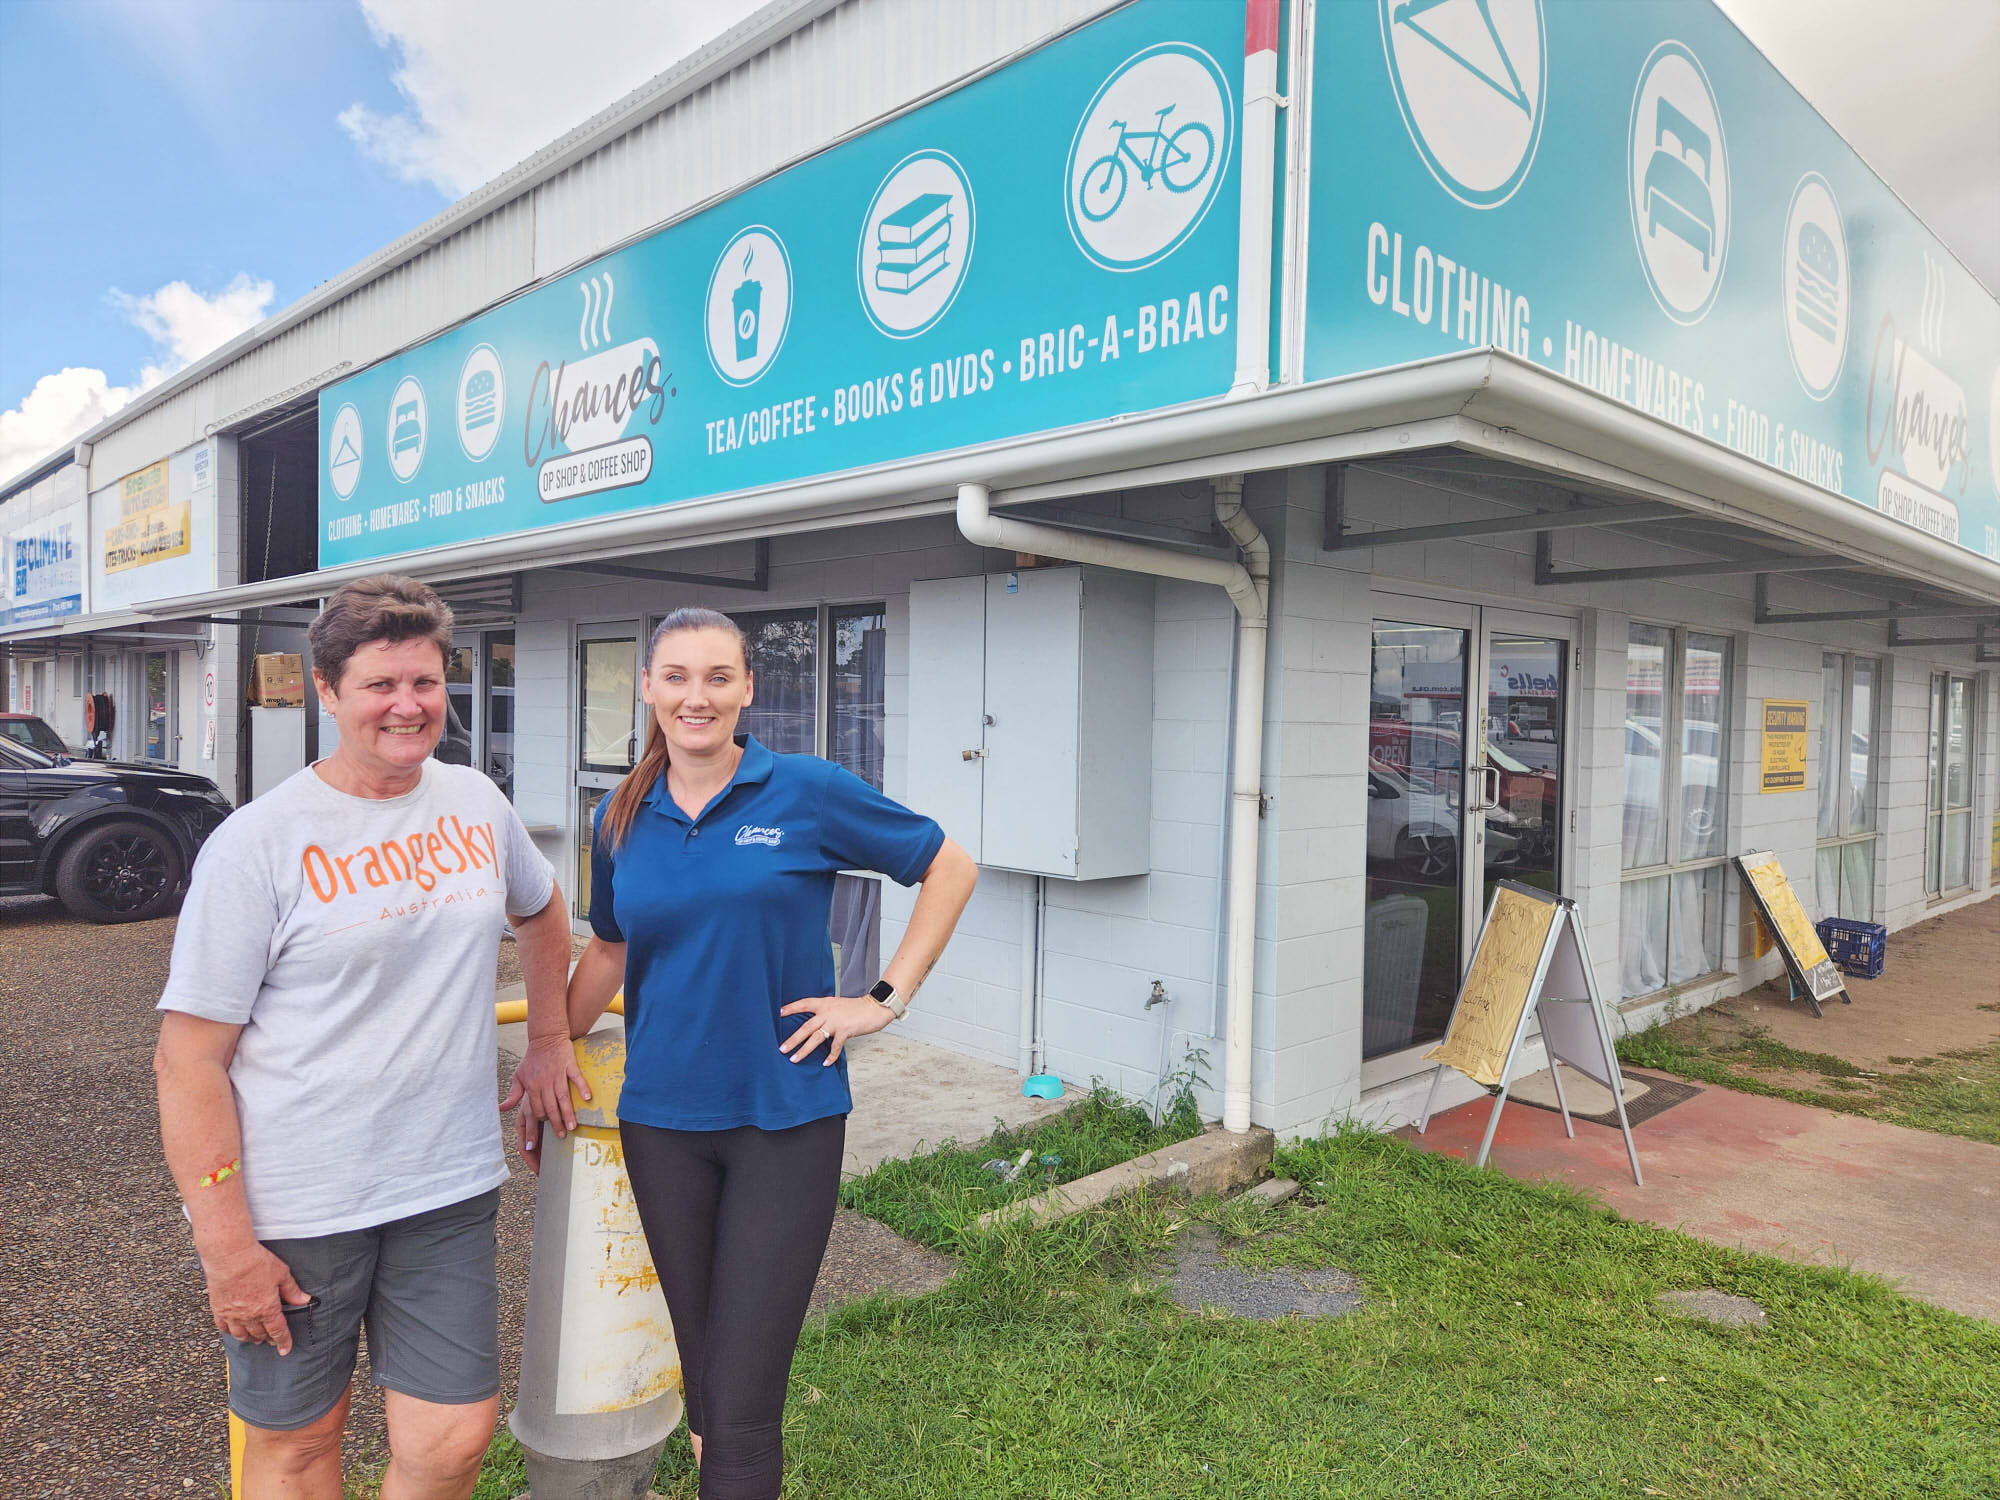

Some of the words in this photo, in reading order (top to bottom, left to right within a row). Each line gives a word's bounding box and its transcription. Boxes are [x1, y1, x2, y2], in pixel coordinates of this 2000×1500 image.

[705, 395, 816, 455] TEA/COFFEE
[833, 372, 904, 426] BOOKS
[909, 367, 924, 407] &
[930, 348, 994, 399] DVDS
[1019, 284, 1228, 382] BRIC-A-BRAC
[1366, 222, 1530, 360] CLOTHING
[1564, 319, 1705, 435] HOMEWARES
[1727, 398, 1768, 463] FOOD
[1774, 423, 1784, 470] &
[1790, 430, 1843, 495] SNACKS
[542, 471, 554, 493] OP
[556, 466, 578, 490] SHOP
[580, 463, 586, 484] &
[588, 456, 619, 483] COFFEE
[621, 449, 647, 478] SHOP
[328, 513, 362, 541] CLOTHING
[370, 498, 420, 533] HOMEWARES
[429, 488, 453, 518] FOOD
[456, 485, 462, 511] &
[465, 476, 505, 510] SNACKS
[28, 522, 72, 571] CLIMATE
[379, 887, 488, 921] Australia
